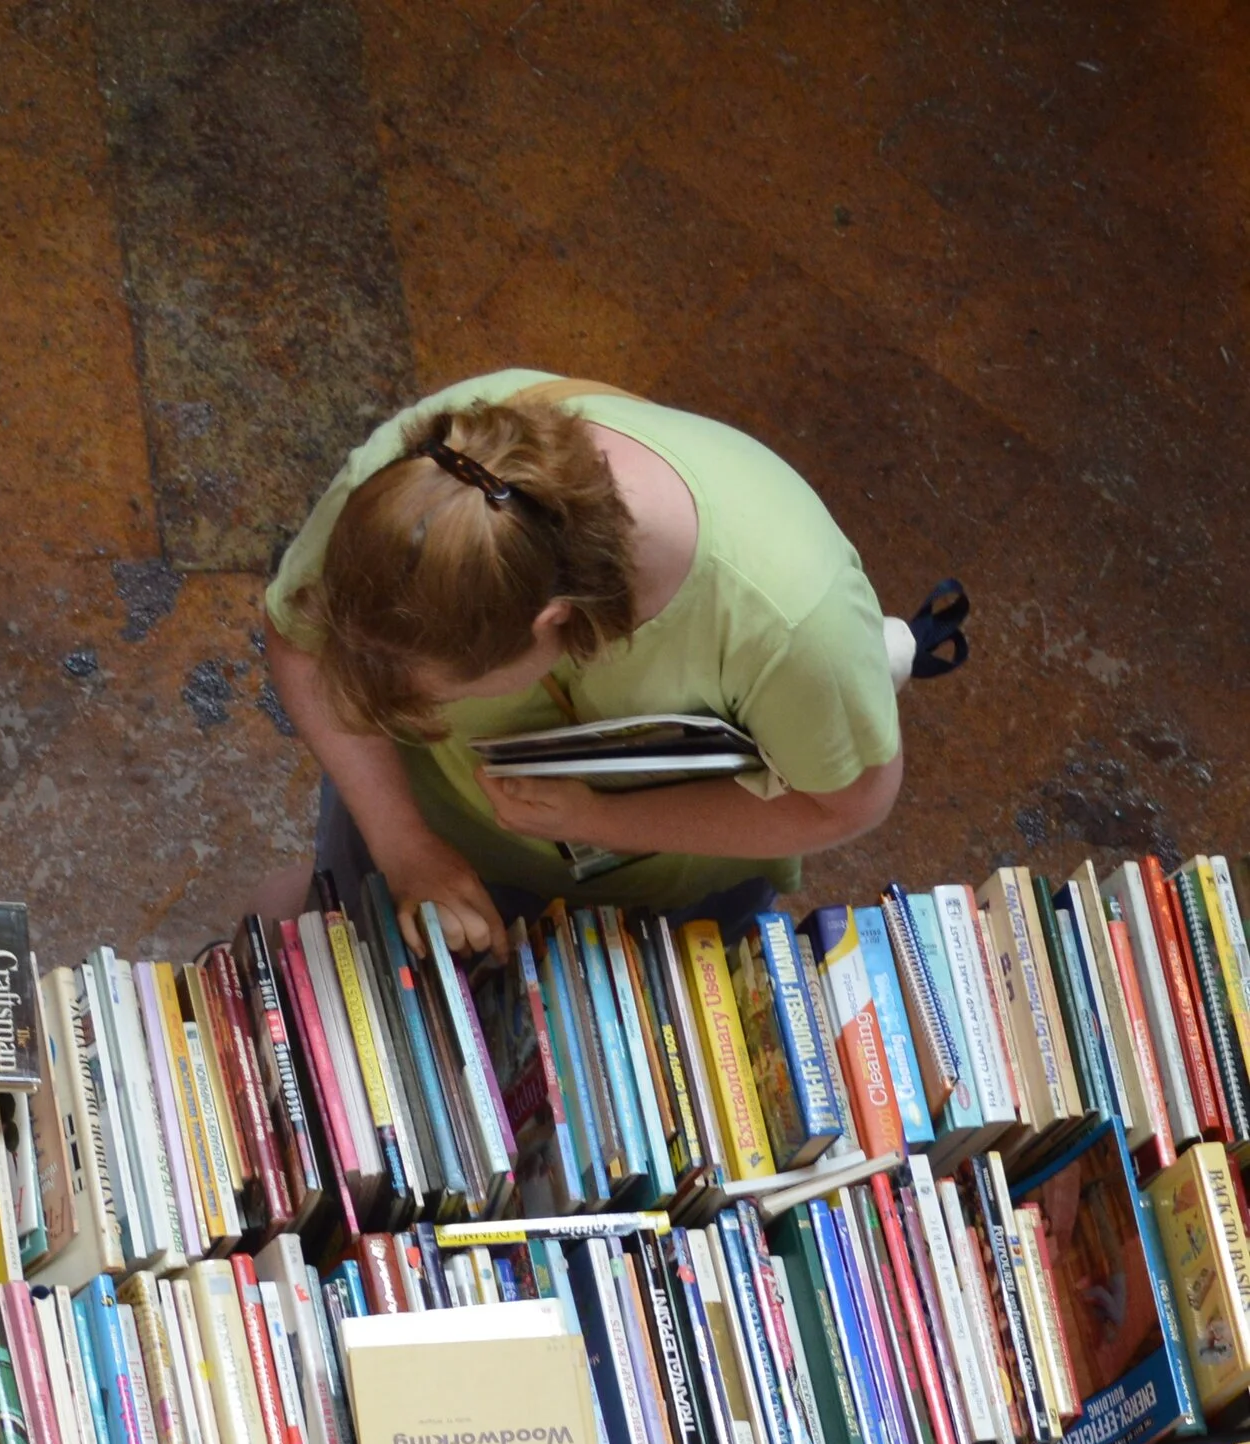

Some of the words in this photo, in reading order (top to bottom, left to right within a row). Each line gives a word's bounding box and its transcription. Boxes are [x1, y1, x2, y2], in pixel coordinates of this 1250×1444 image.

[763, 916, 798, 985] MANUAL
[948, 924, 962, 950] LAST
[257, 976, 277, 1010] DIME
[958, 964, 972, 995] MAKE
[965, 996, 979, 1022] AND
[709, 1008, 758, 1151] Extraordinary
[844, 1009, 903, 1108] Cleaning
[887, 1032, 921, 1100] Cleaning
[974, 1038, 990, 1073] CLEAN
[271, 1041, 305, 1122] DECORATING
[157, 1153, 175, 1198] IDEAS
[166, 1203, 185, 1253] BRIGHT
[1206, 1167, 1234, 1216] BACK
[1221, 1220, 1240, 1243] TO
[991, 1223, 1016, 1293] POTPOURRI
[1083, 1381, 1129, 1423] BUILDING
